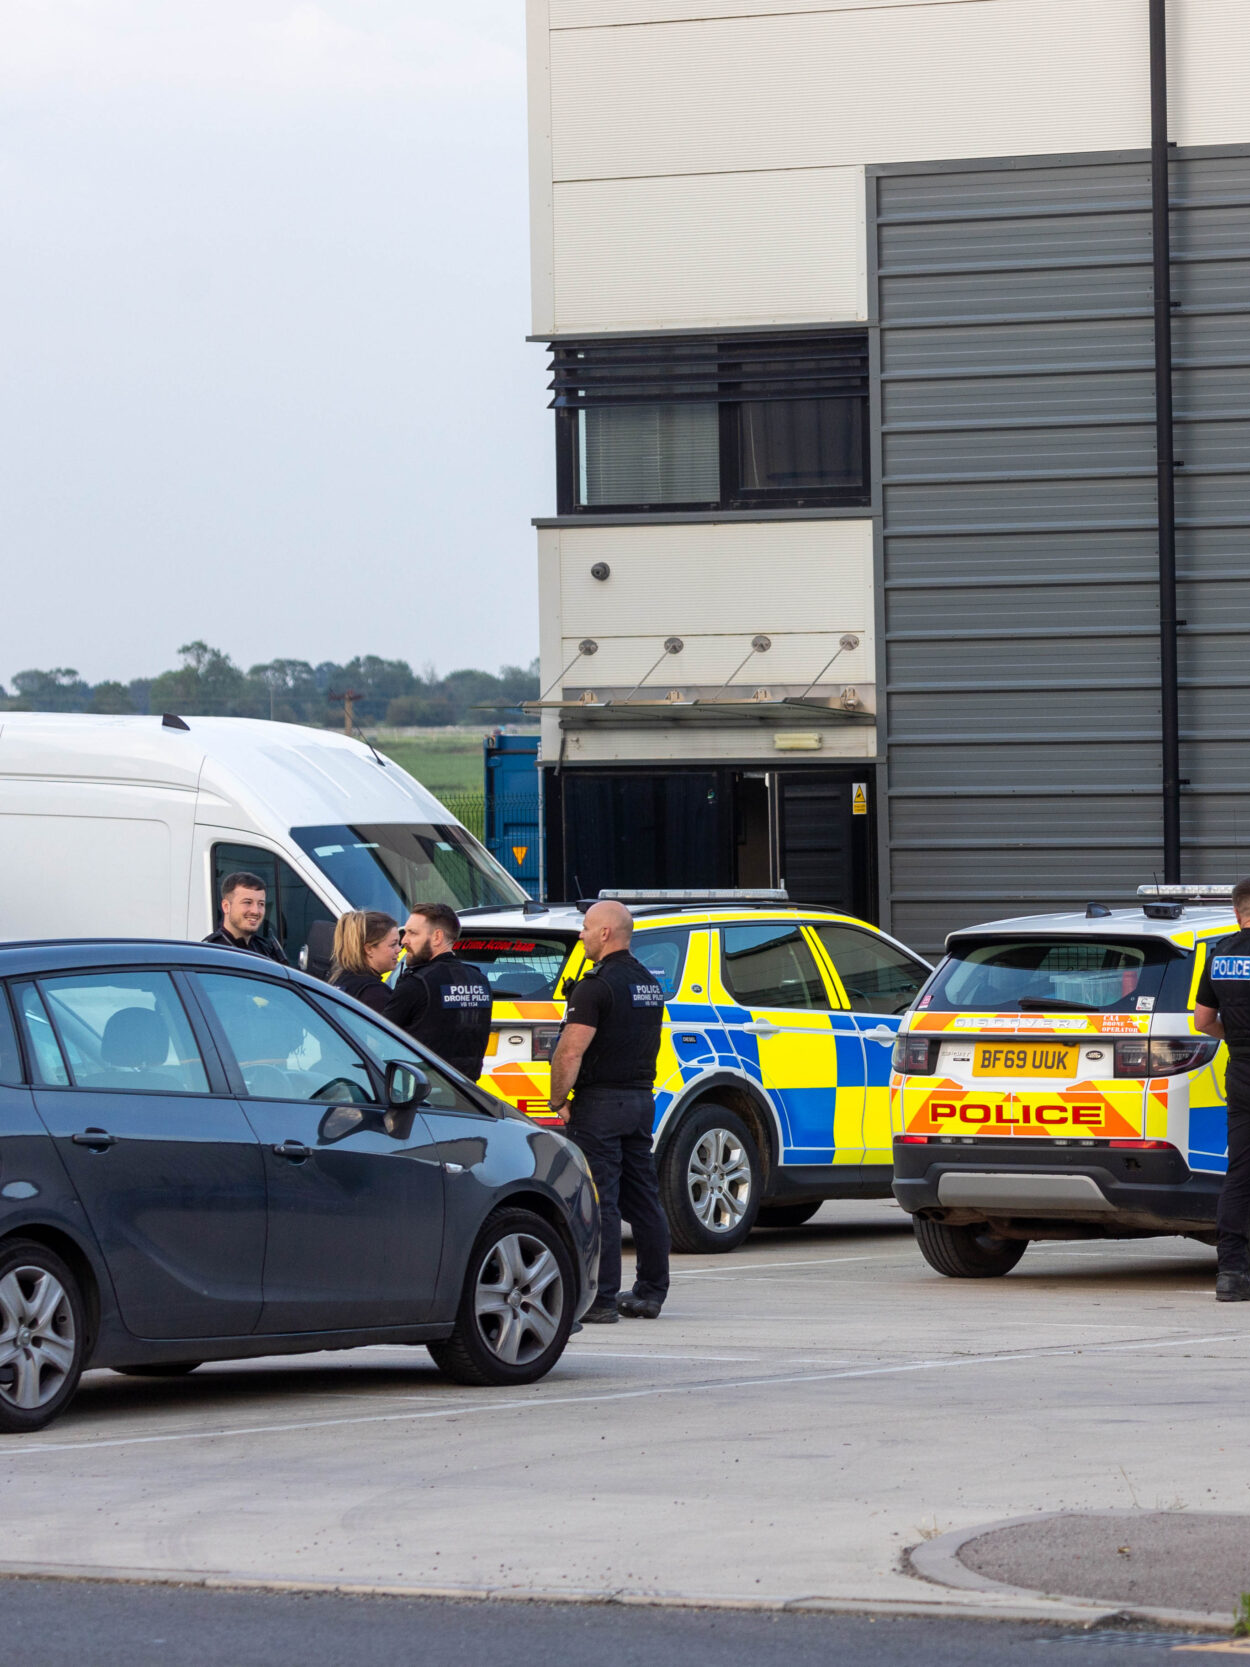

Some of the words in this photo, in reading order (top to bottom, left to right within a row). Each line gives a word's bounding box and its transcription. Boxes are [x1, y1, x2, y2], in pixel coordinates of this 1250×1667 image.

[1213, 959, 1250, 976] POLICE
[450, 985, 484, 995] POLICE
[636, 984, 660, 994] POLICE
[444, 994, 469, 1002] DRONE
[471, 994, 489, 1002] PILOT
[955, 1018, 1087, 1029] DISCOVERY
[981, 1050, 1027, 1069] BF69
[1032, 1050, 1069, 1070] UUK
[931, 1103, 1102, 1125] POLICE
